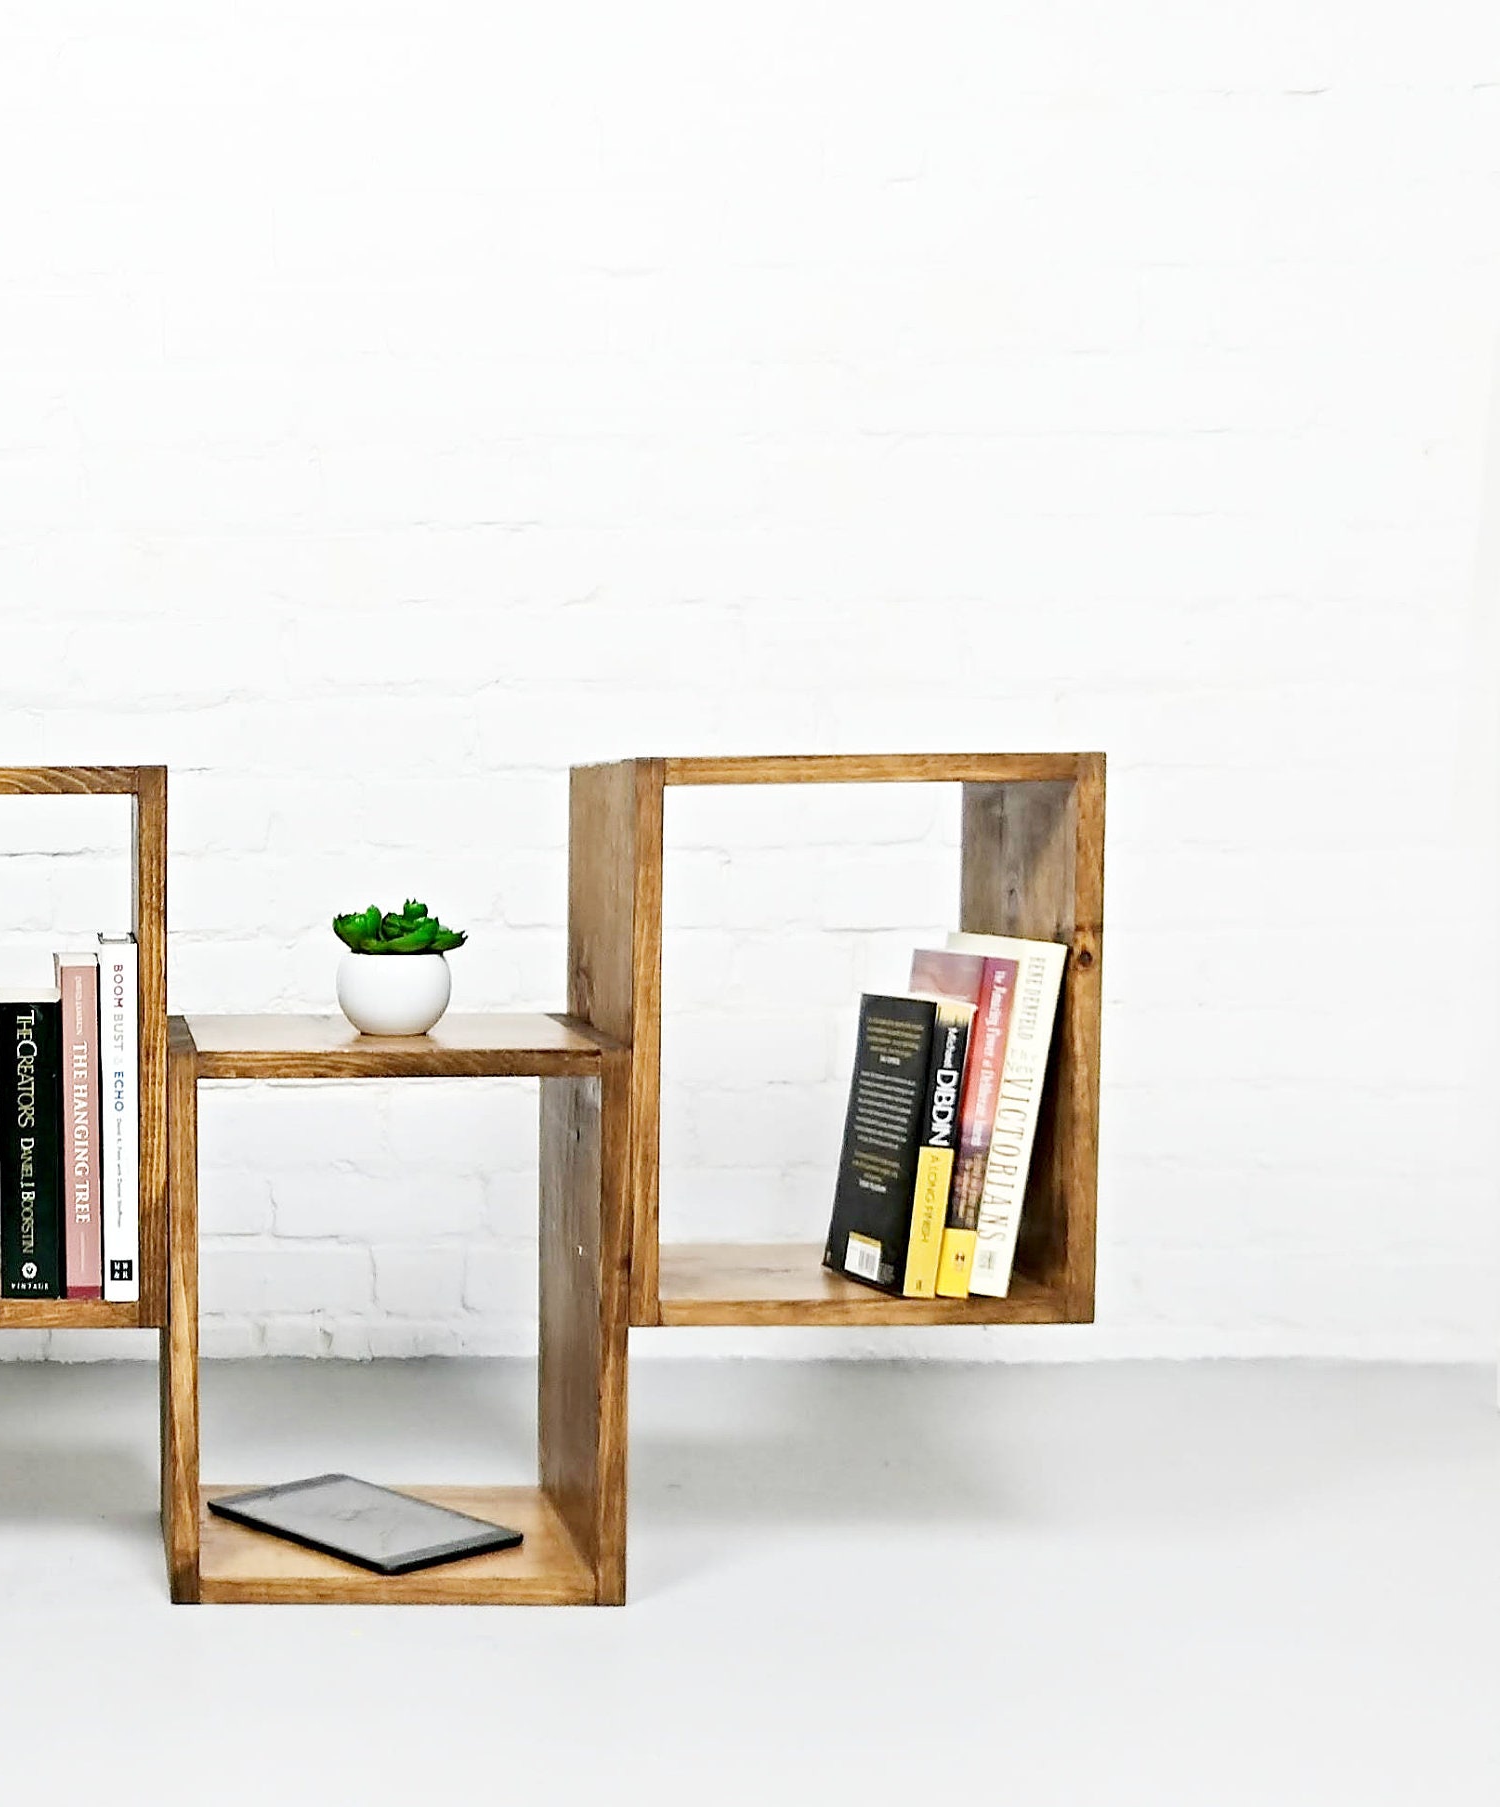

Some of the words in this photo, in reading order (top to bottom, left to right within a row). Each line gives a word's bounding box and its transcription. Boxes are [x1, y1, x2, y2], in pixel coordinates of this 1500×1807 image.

[113, 964, 124, 1008] BOOM
[16, 1009, 35, 1040] THE
[113, 1014, 124, 1051] BUST
[73, 1041, 88, 1080] THE
[16, 1039, 37, 1128] CREATORS
[114, 1071, 124, 1112] ECHO
[928, 1068, 960, 1146] DIBDIN
[74, 1084, 90, 1177] HANGING
[978, 1078, 1033, 1242] VICTORIANS
[75, 1180, 90, 1224] TREE
